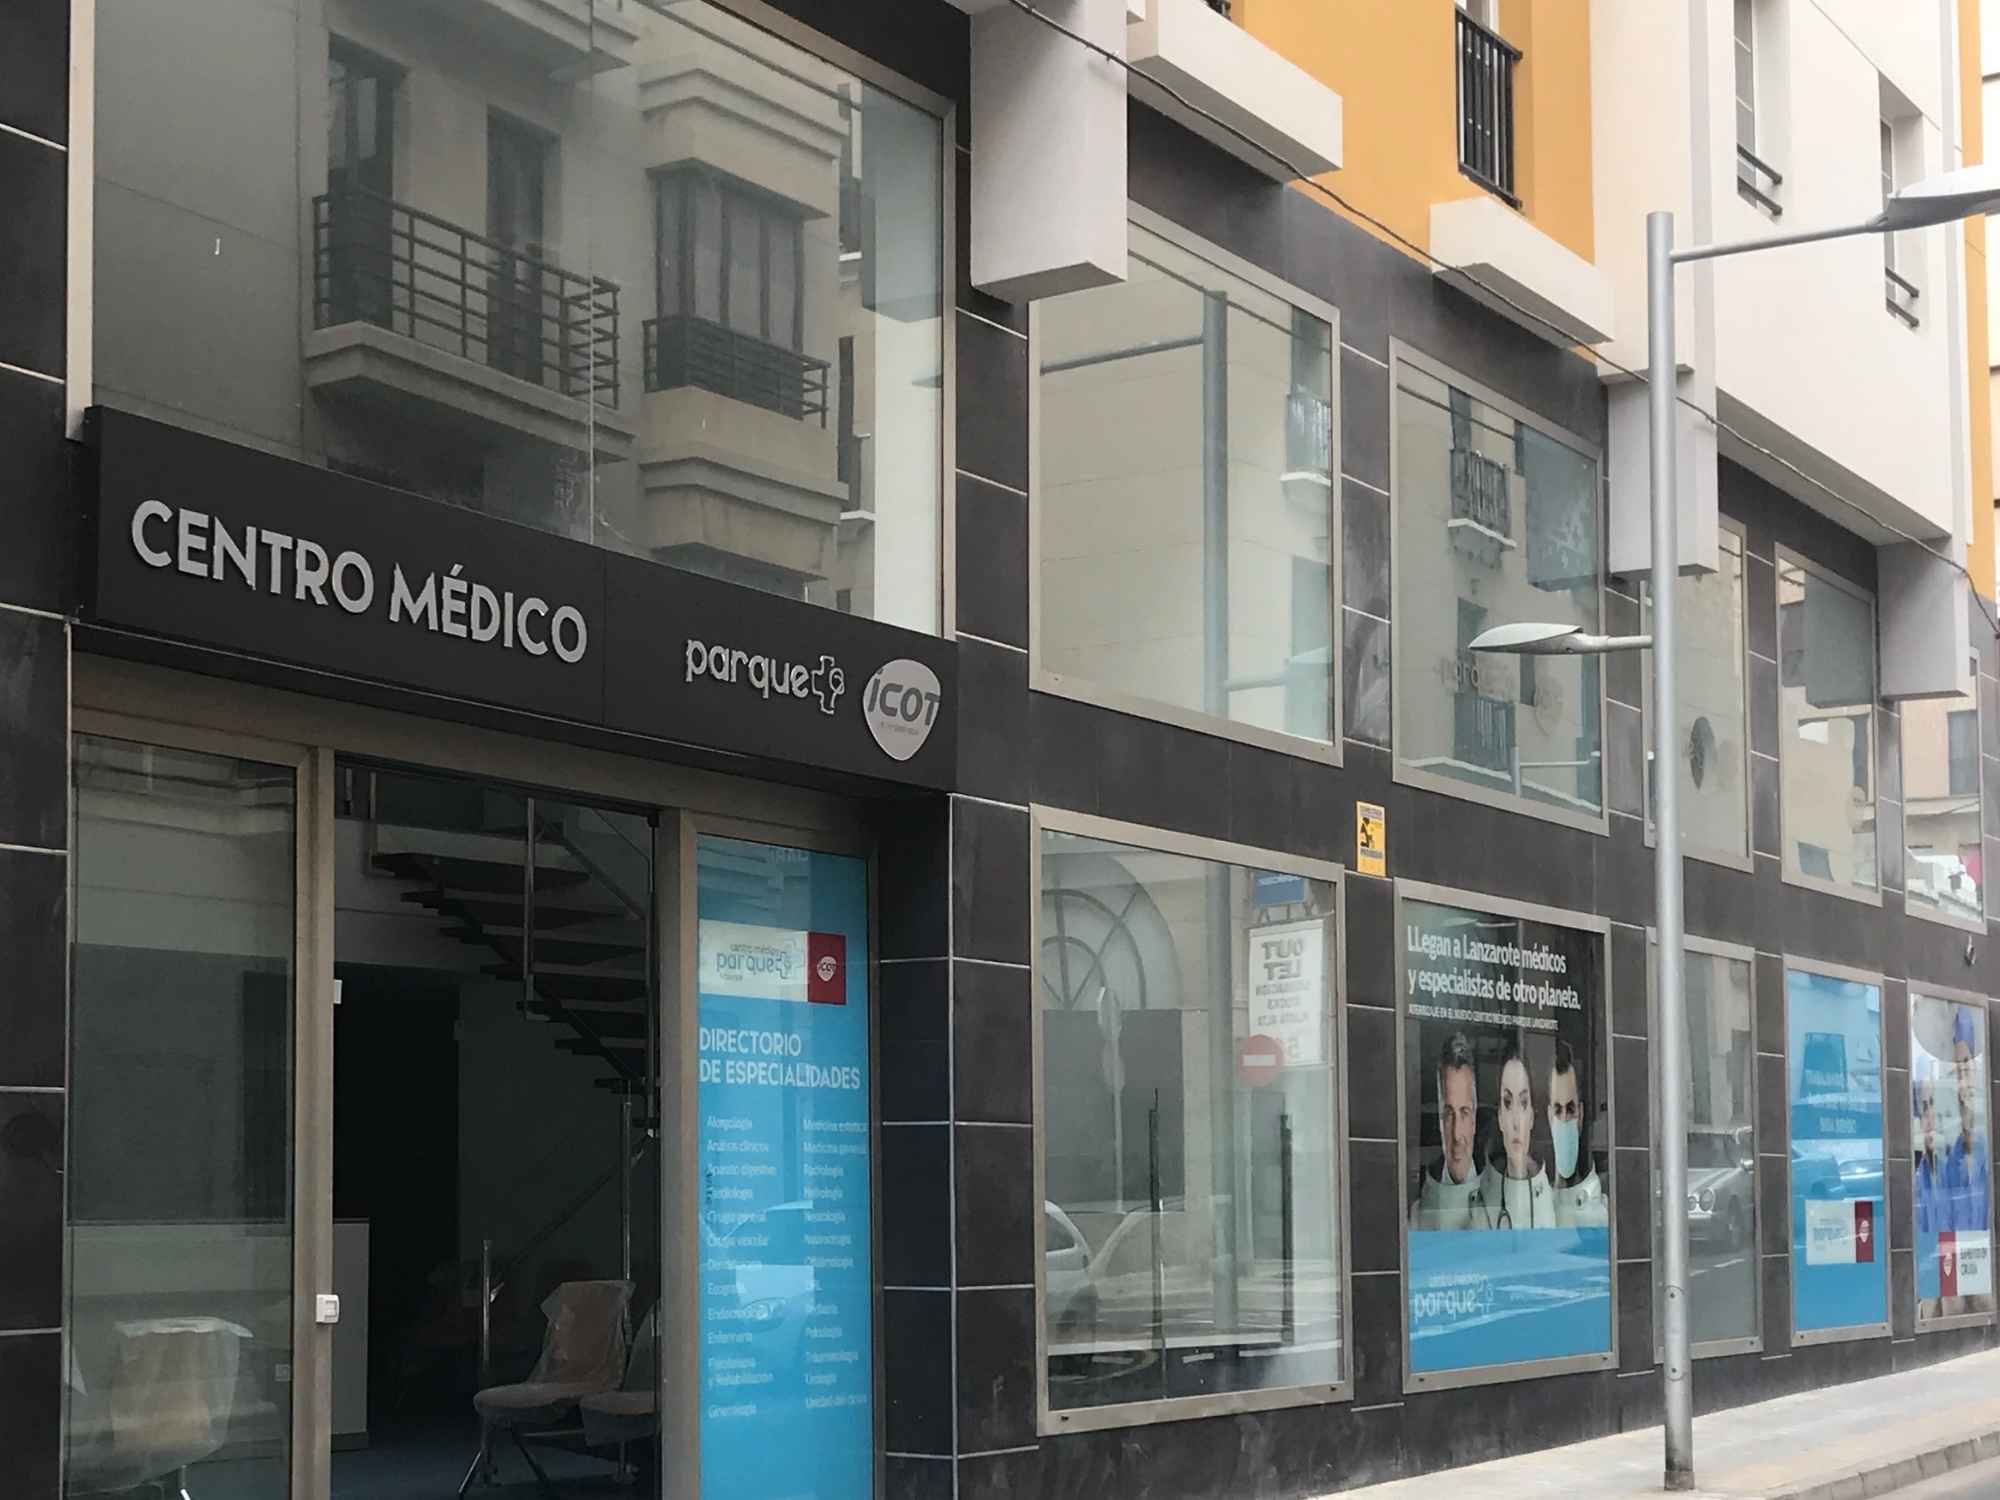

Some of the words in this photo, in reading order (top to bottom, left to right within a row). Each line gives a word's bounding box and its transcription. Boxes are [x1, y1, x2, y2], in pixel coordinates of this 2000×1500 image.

[131, 499, 375, 614] CENTRO
[389, 563, 588, 663] MÉDICO
[686, 639, 809, 699] parque
[716, 952, 774, 975] parque
[1453, 938, 1462, 958] a
[1463, 934, 1520, 967] Lanzarote
[1521, 942, 1567, 973] médicos
[1407, 968, 1417, 995] y
[1418, 967, 1494, 998] especialistas
[1496, 974, 1511, 1001] de
[1513, 978, 1537, 1004] otro
[1538, 980, 1581, 1011] planeta.
[700, 1027, 801, 1056] DIRECTORIO
[700, 1059, 721, 1084] DE
[726, 1060, 861, 1089] ESPECIALIDADES
[1414, 1289, 1476, 1325] parque
